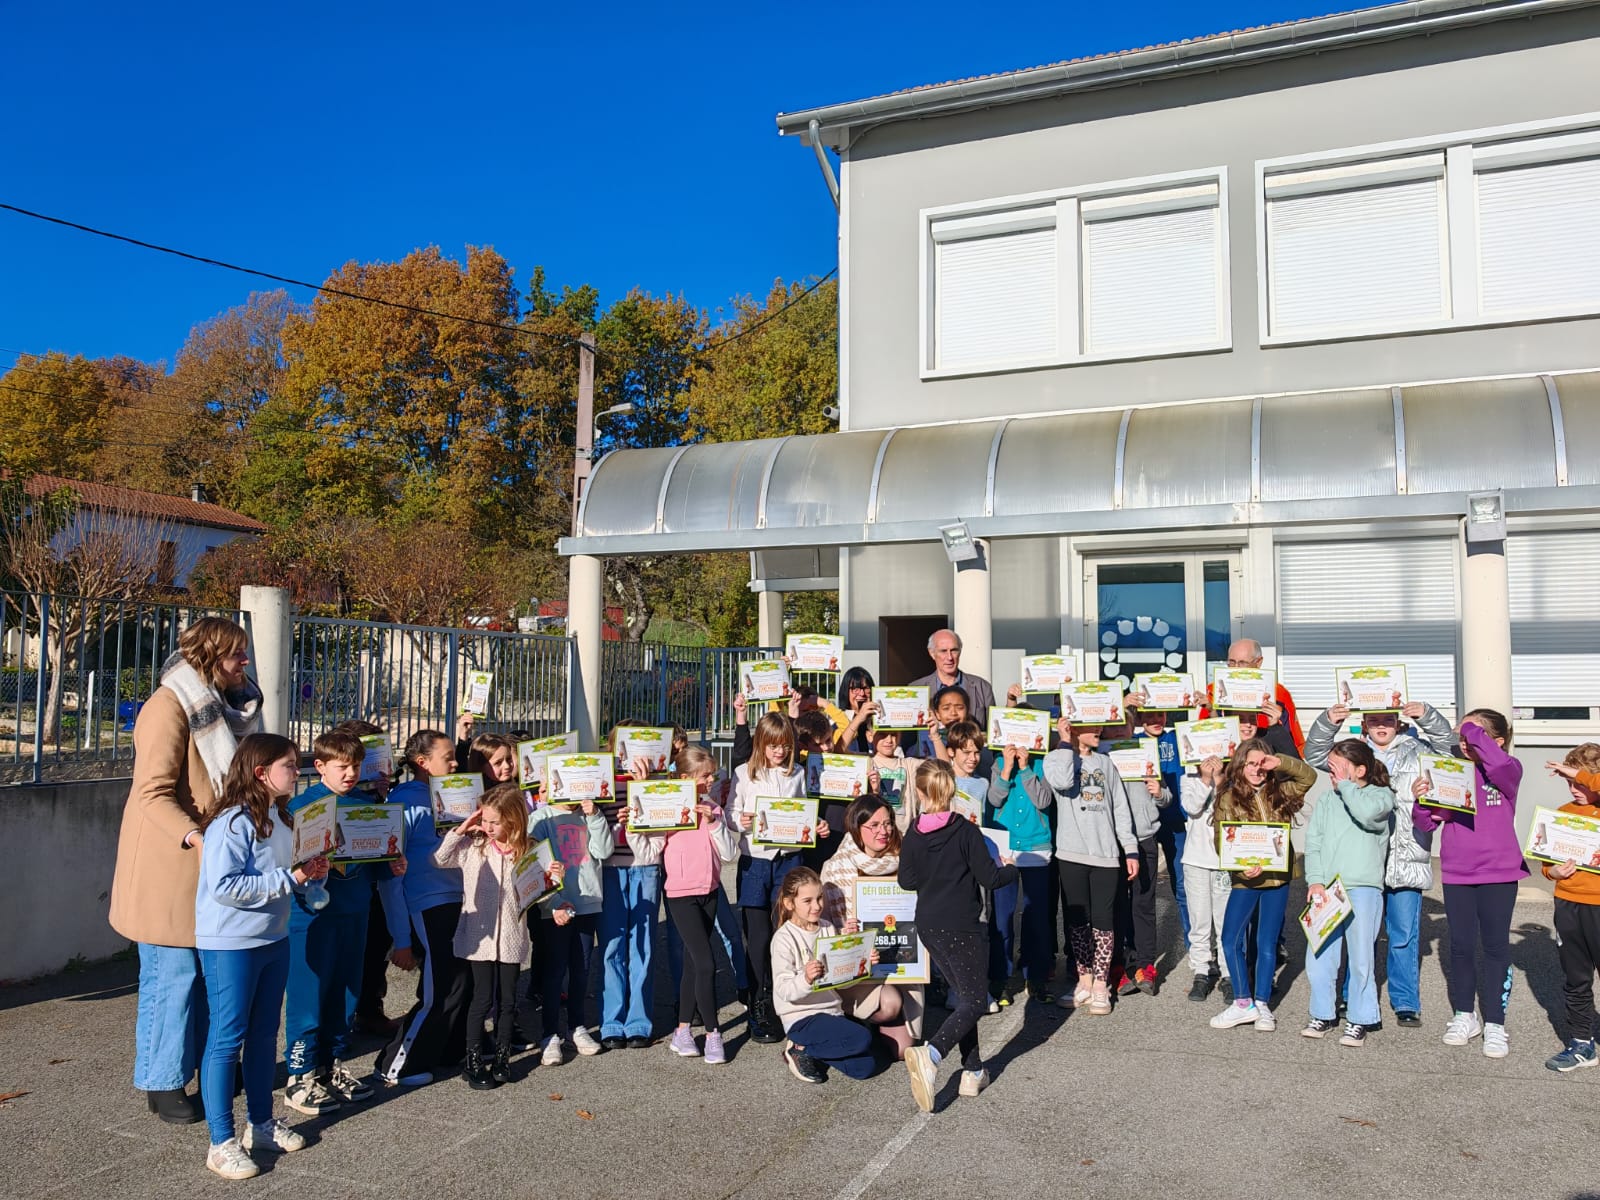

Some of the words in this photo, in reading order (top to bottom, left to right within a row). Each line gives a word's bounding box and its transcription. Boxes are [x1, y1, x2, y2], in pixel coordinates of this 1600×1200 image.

[862, 884, 877, 896] DÉFI
[878, 886, 891, 896] DES
[897, 935, 908, 945] KG
